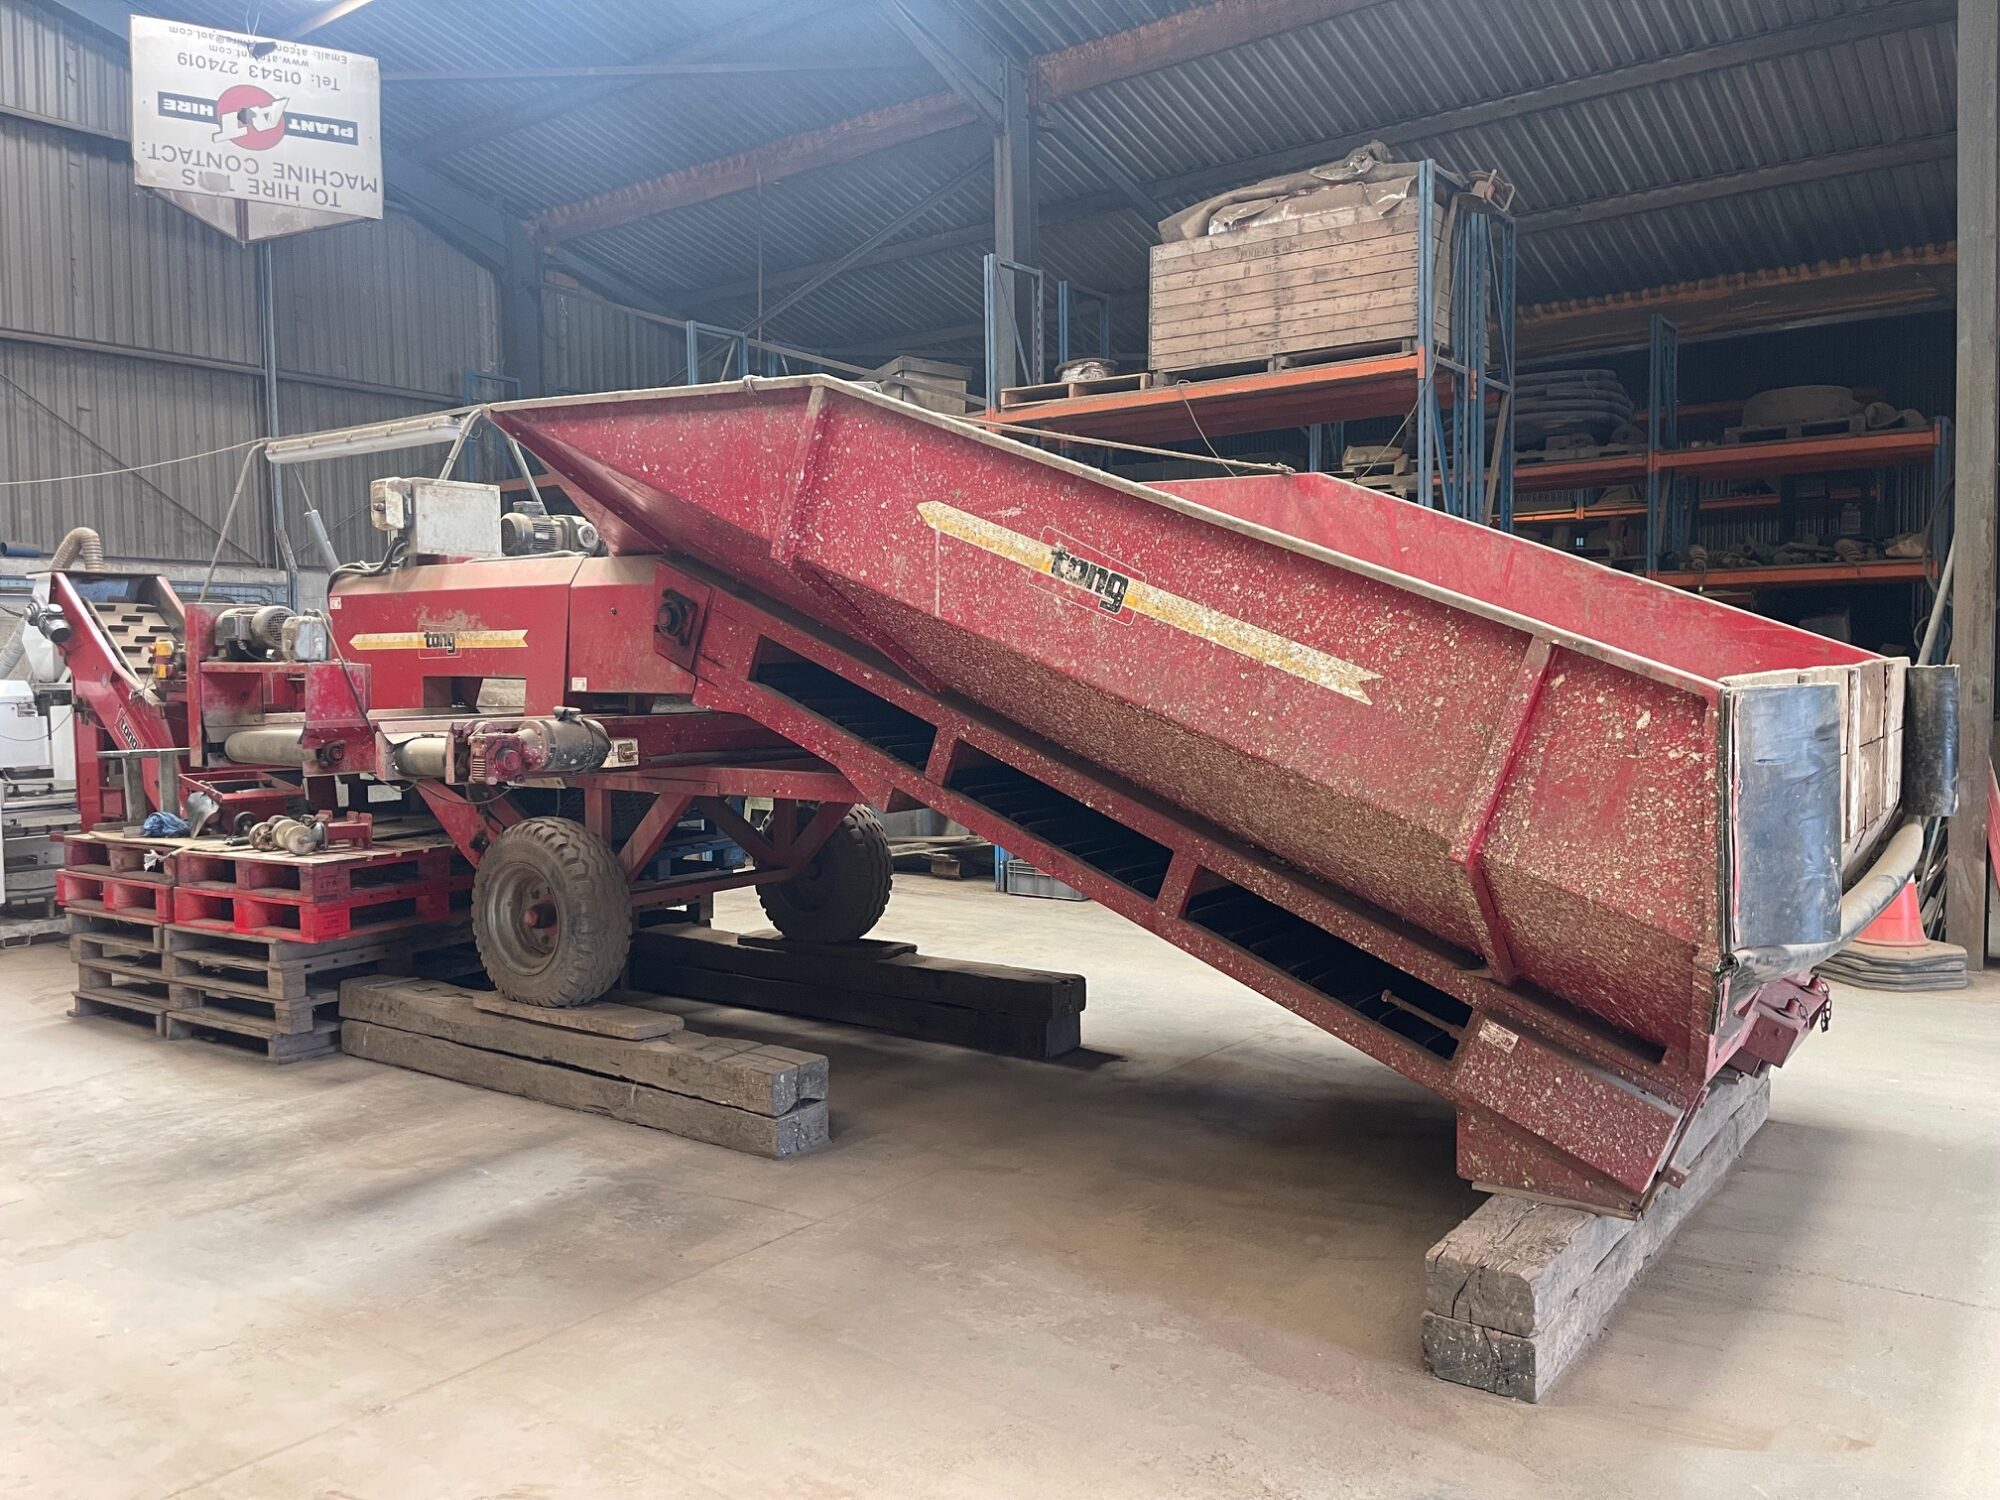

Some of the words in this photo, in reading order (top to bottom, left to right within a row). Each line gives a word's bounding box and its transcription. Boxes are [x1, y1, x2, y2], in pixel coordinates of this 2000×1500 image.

[177, 52, 239, 75] 274019
[313, 50, 348, 65] Email:
[248, 65, 302, 85] 01543
[311, 74, 341, 91] Tel:
[163, 98, 214, 117] HIRE
[288, 118, 354, 138] PLANT
[142, 141, 259, 175] CONTACT:
[273, 161, 378, 193] MACHINE
[247, 178, 299, 202] HIRE
[312, 188, 342, 208] TO
[1051, 545, 1129, 614] tong
[424, 631, 456, 654] tong
